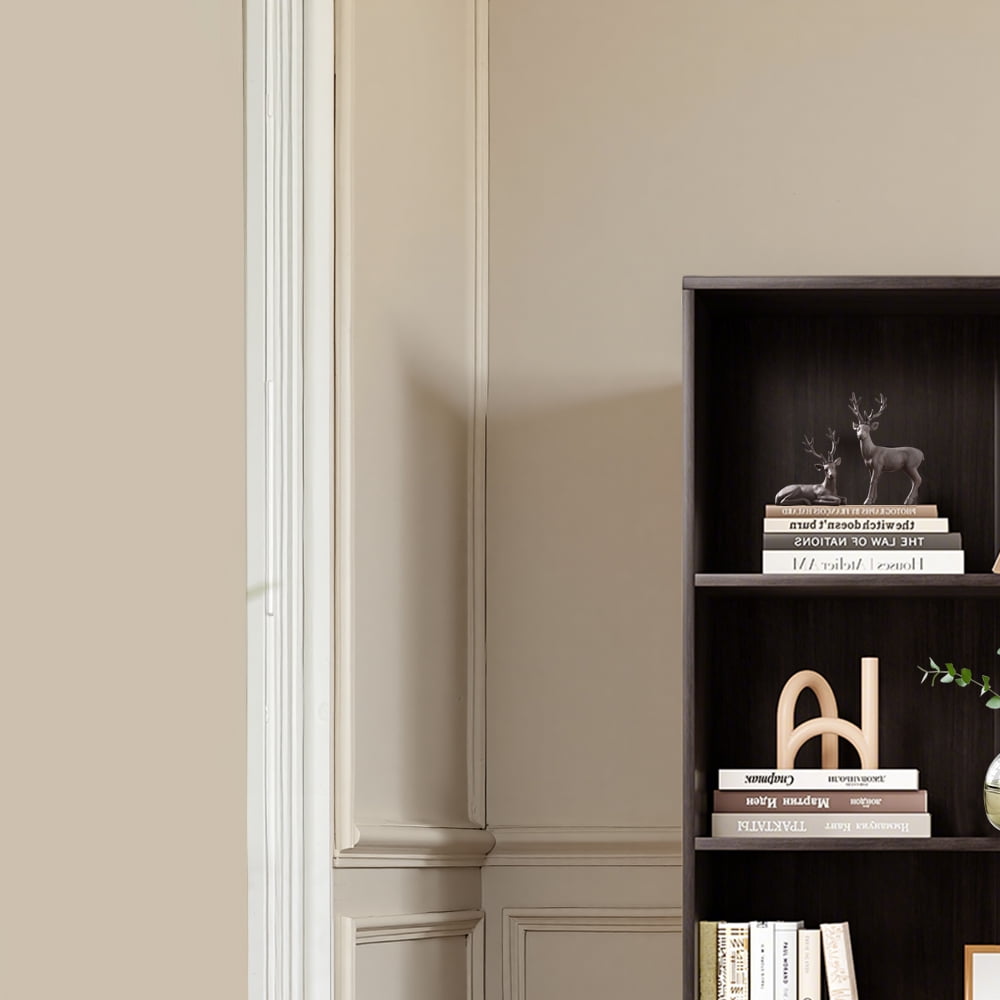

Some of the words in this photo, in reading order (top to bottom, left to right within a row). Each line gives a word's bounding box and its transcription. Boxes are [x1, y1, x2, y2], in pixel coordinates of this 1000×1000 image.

[744, 773, 794, 786] Спартак
[746, 796, 777, 808] Иден
[783, 796, 830, 808] Мартин
[738, 820, 807, 832] ТРАКТАТЫ
[825, 822, 851, 831] Кант
